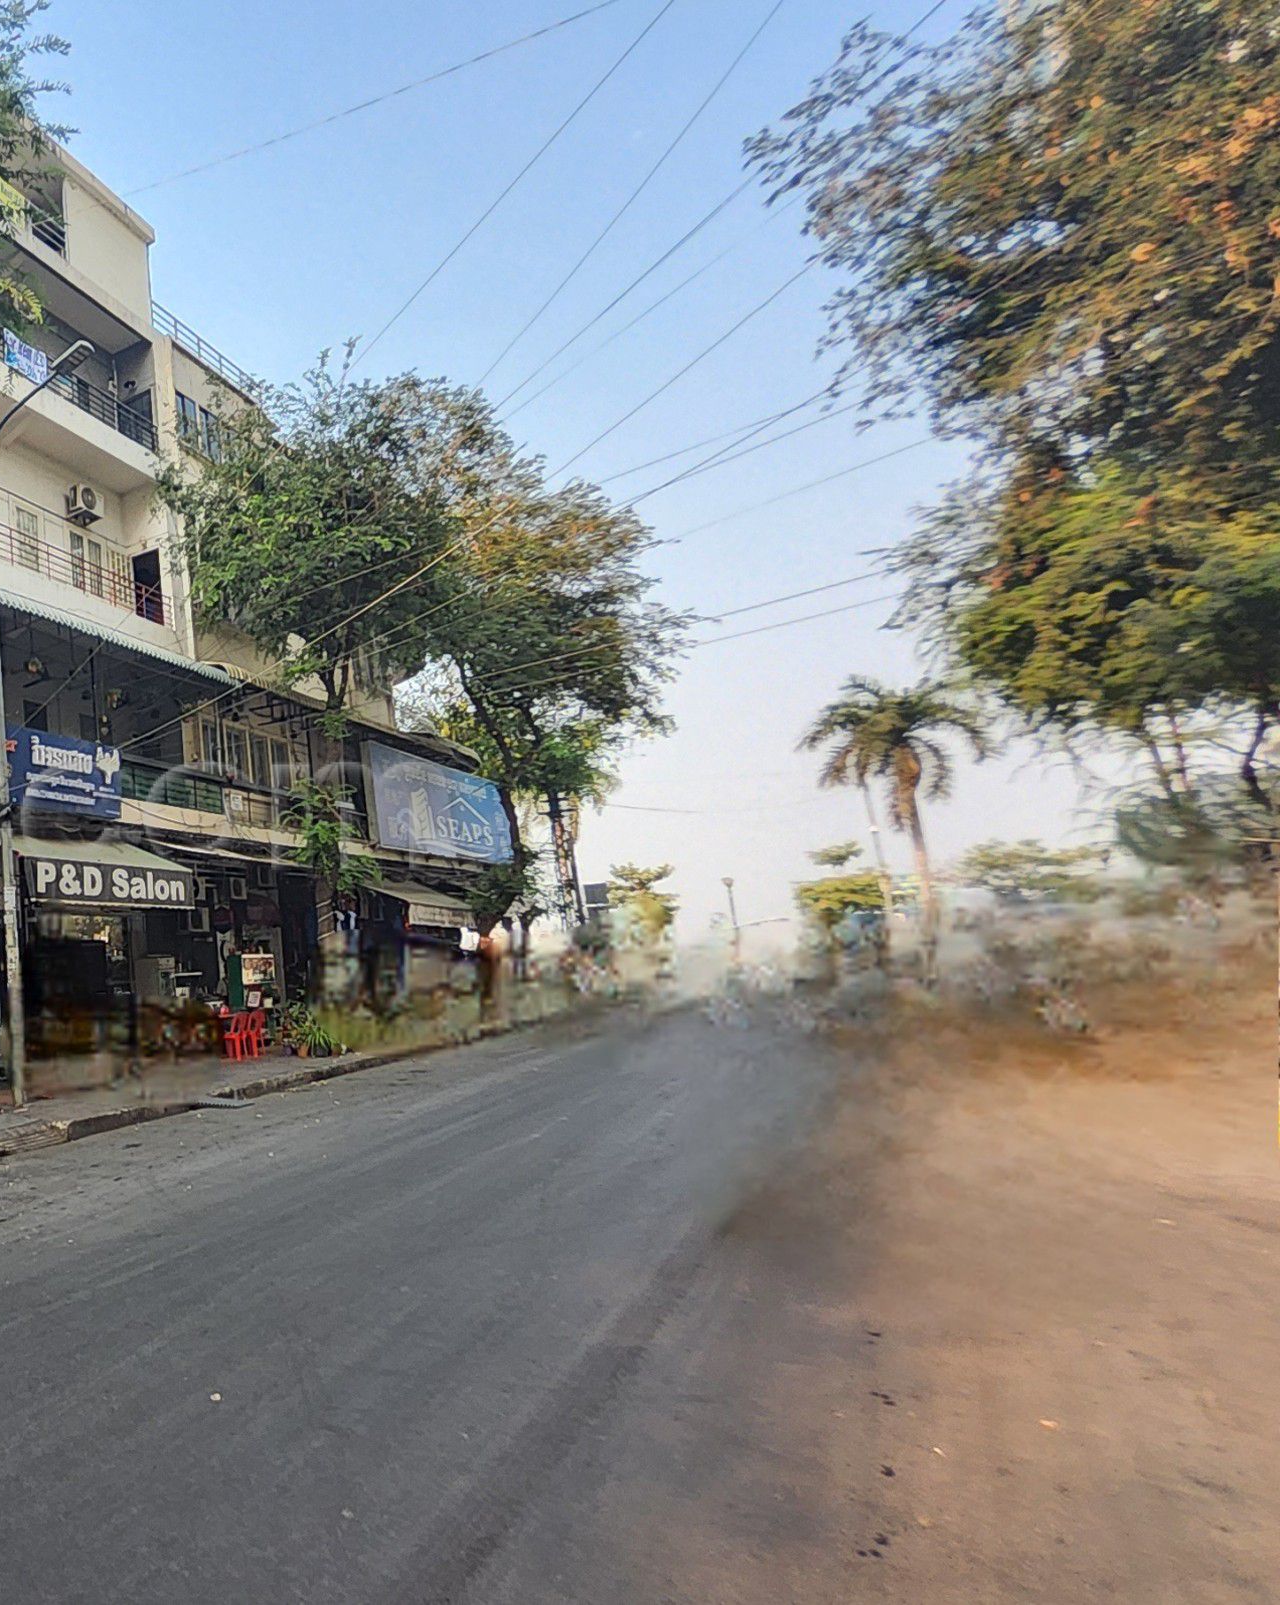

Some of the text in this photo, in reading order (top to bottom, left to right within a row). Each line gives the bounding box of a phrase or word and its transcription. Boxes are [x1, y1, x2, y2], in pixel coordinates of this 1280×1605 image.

[436, 815, 494, 847] SEAPS
[36, 861, 186, 902] P&D Salon
